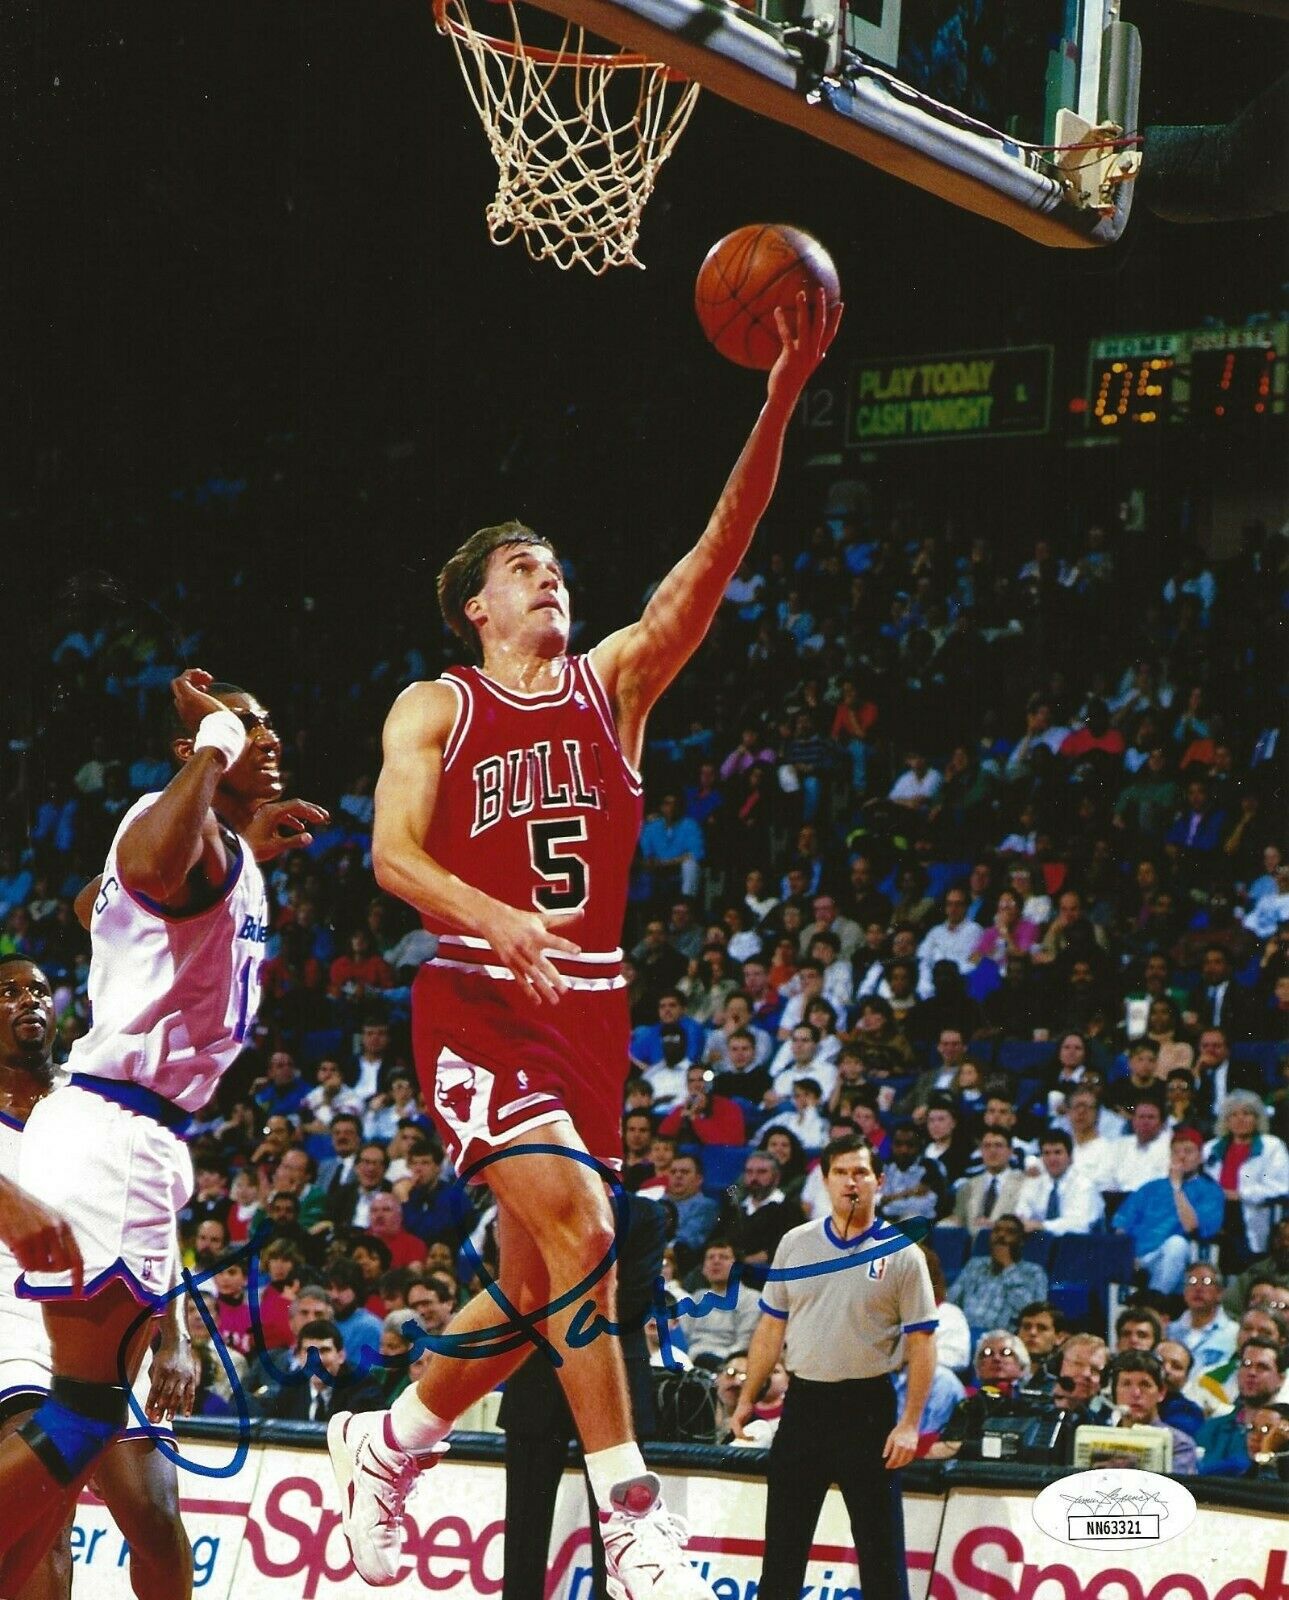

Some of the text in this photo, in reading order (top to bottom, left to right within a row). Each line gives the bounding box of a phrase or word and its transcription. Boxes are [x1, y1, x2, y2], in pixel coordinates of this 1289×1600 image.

[860, 360, 995, 399] PLAY TODAY
[857, 395, 994, 436] CASH TONIGHT
[470, 739, 609, 838] BULL
[526, 815, 589, 915] 5
